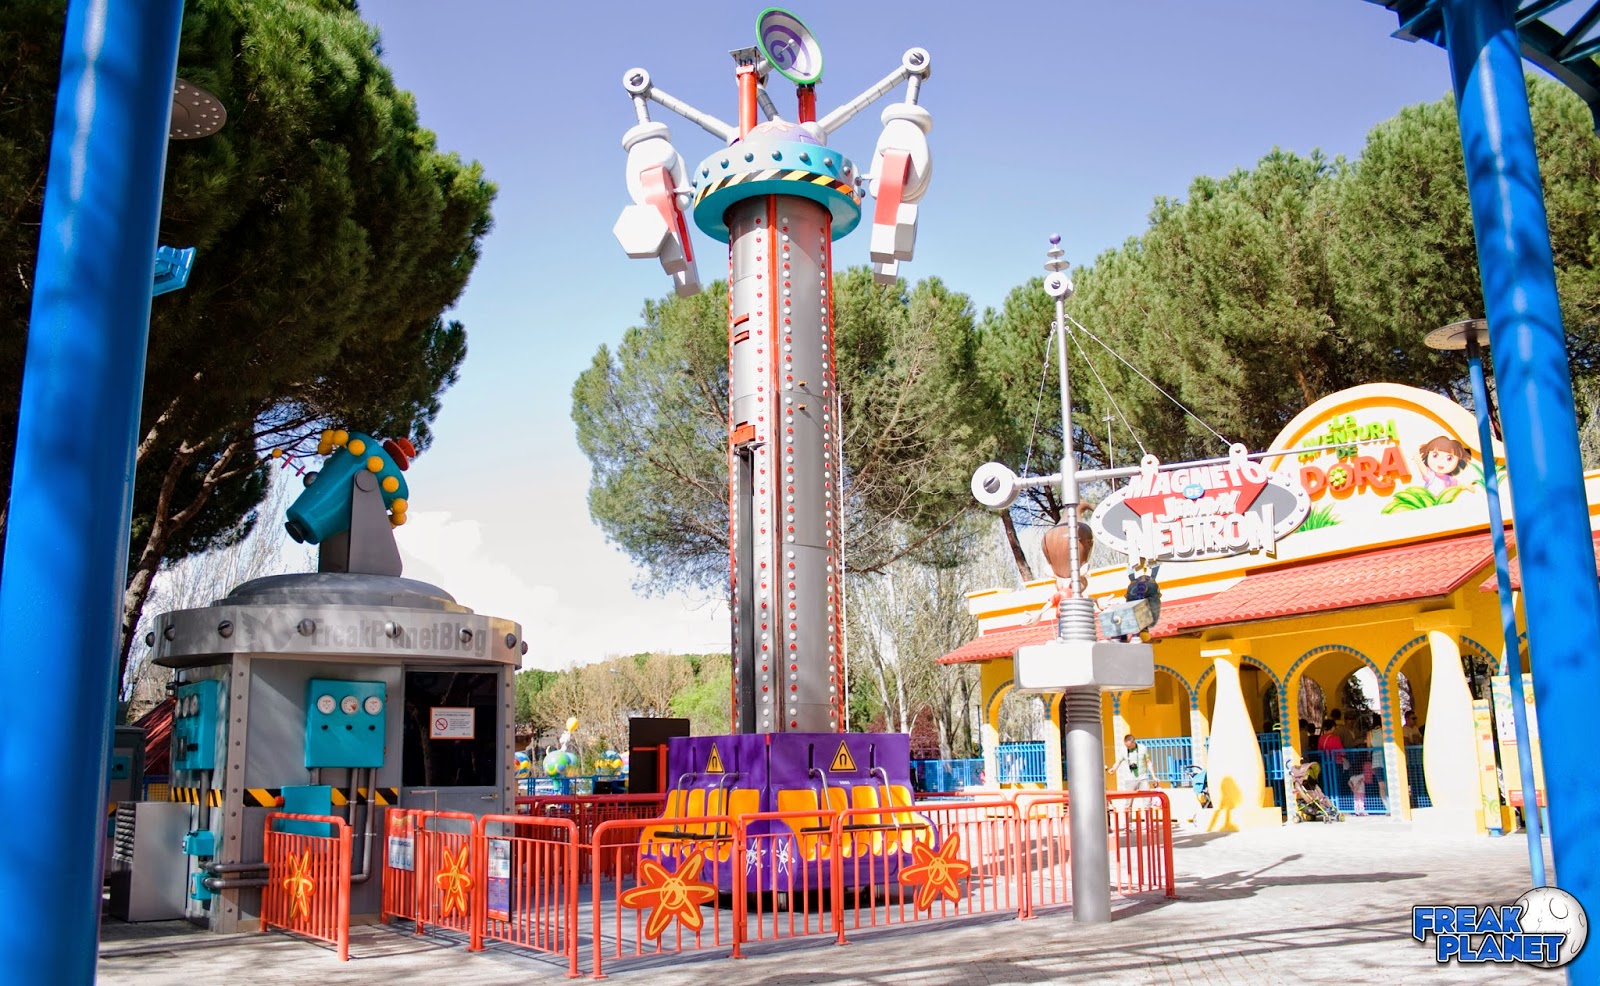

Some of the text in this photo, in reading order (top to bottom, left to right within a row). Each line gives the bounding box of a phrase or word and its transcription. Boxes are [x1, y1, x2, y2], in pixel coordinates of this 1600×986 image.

[1299, 419, 1400, 461] AVENTURA
[1336, 444, 1358, 460] DE
[1122, 461, 1268, 498] MAGNETO
[1299, 446, 1410, 496] DORA
[1185, 486, 1202, 498] DE
[1122, 503, 1277, 569] NEUTRON
